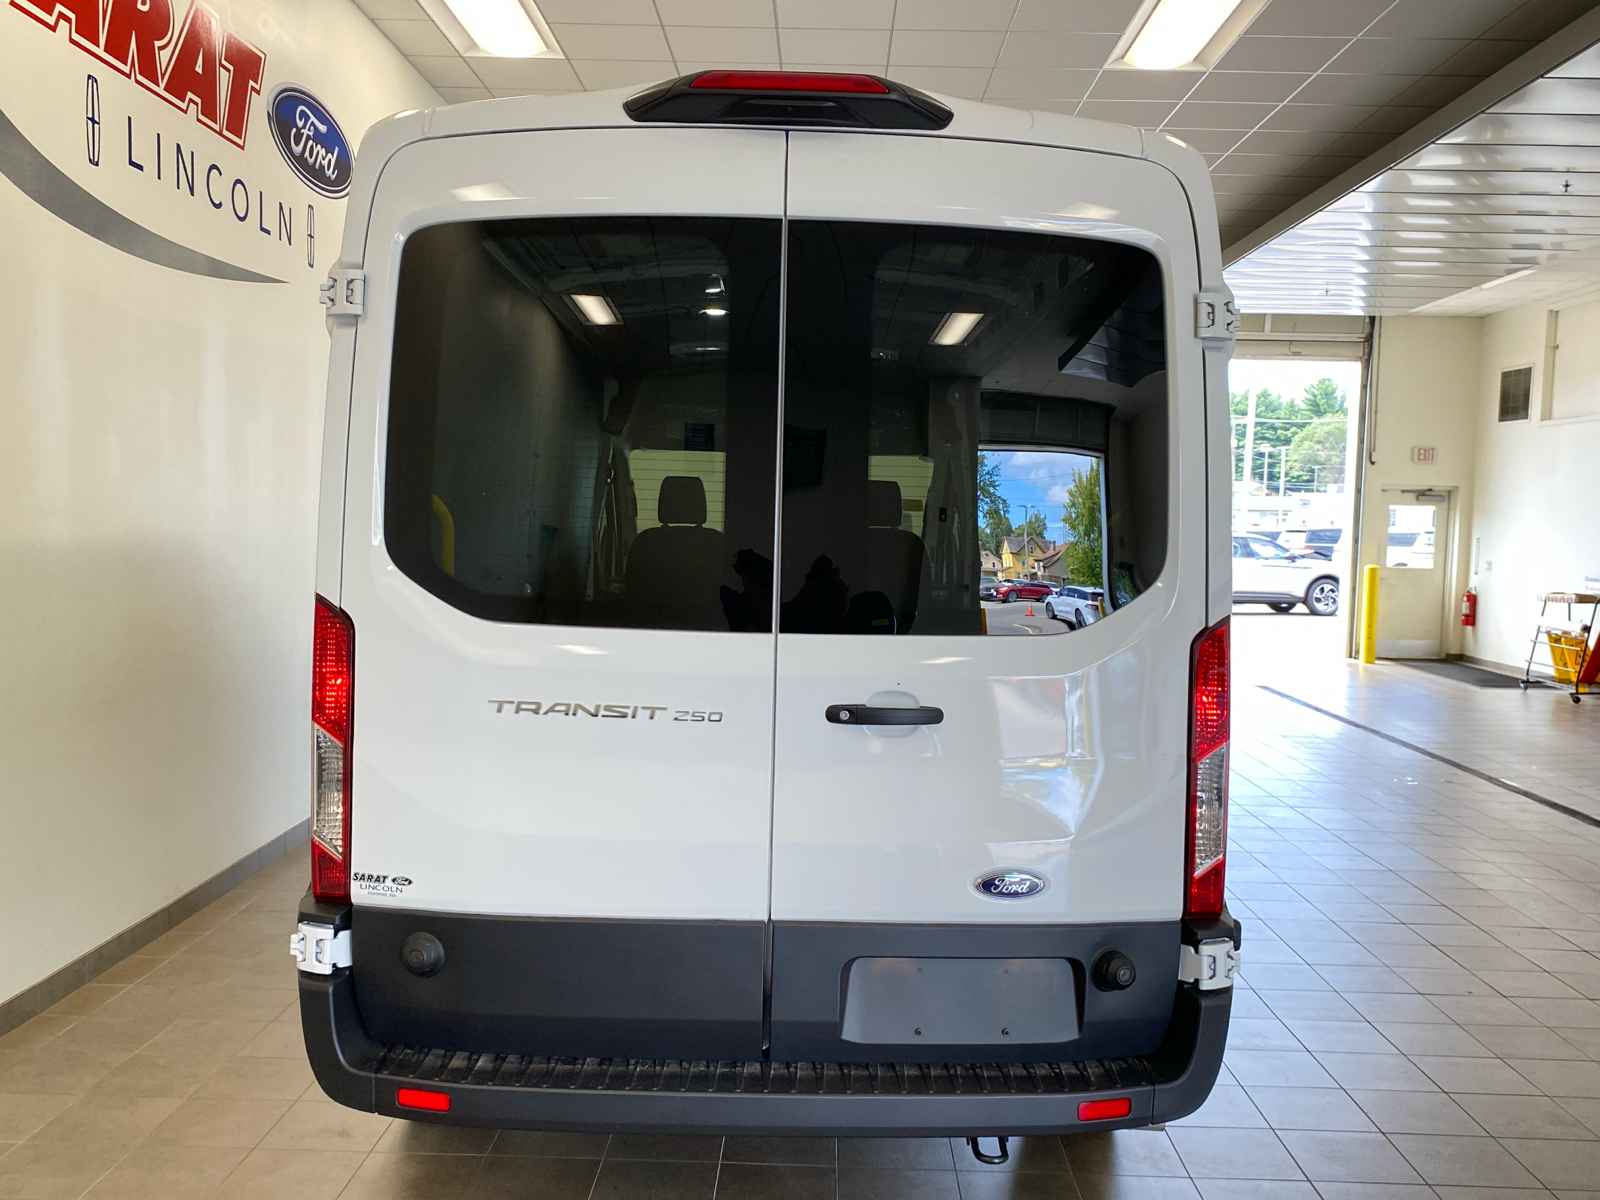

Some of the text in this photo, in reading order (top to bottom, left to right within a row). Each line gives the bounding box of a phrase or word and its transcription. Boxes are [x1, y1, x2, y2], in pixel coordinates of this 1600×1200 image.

[290, 104, 339, 181] Ford
[127, 115, 292, 246] LINCOLN
[1417, 447, 1436, 461] EXIT
[488, 699, 723, 722] TRANSIT 250
[352, 872, 389, 884] SARAT
[991, 877, 1030, 893] Ford
[359, 883, 403, 893] LINCOLN
